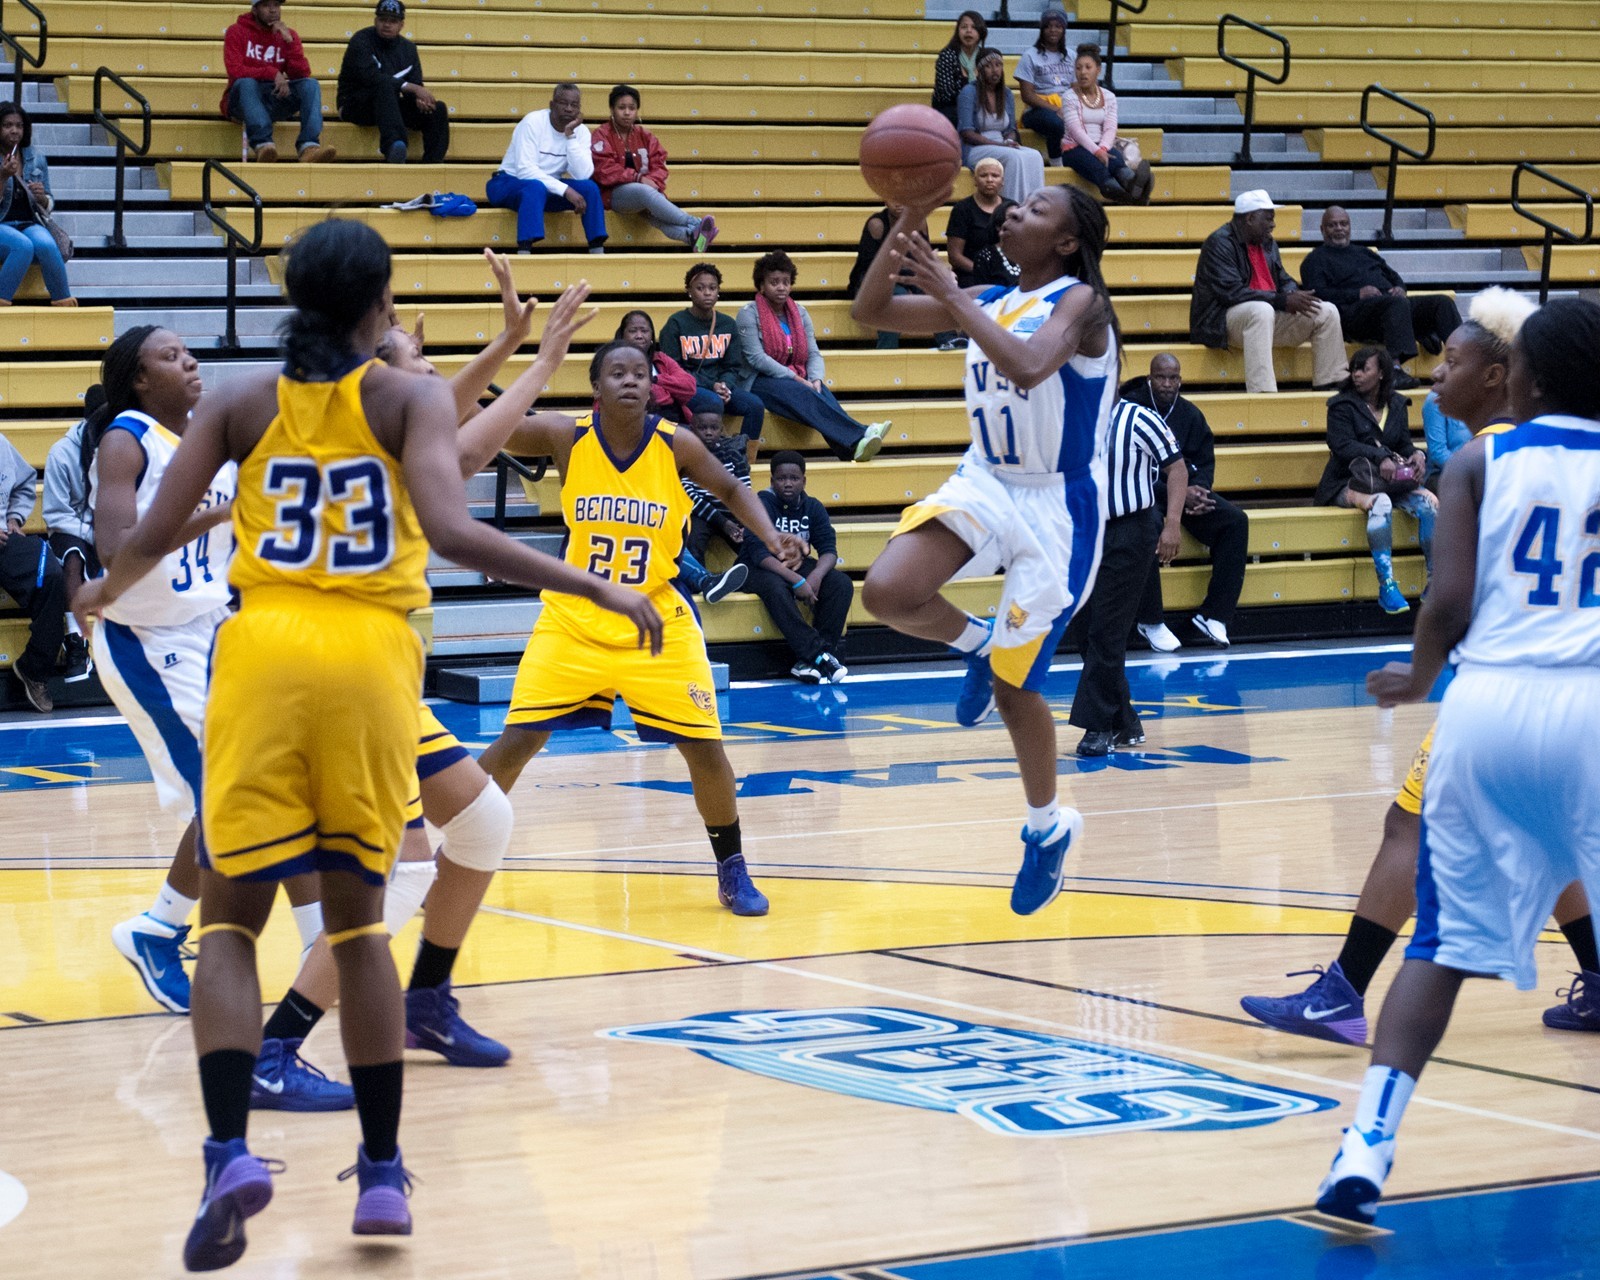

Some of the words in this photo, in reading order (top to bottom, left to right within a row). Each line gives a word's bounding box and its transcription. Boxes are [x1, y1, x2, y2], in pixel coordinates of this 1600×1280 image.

[971, 404, 1024, 466] 11
[254, 455, 396, 575] 33
[575, 495, 668, 530] BENEDICT
[171, 531, 214, 593] 34
[587, 532, 653, 585] 23
